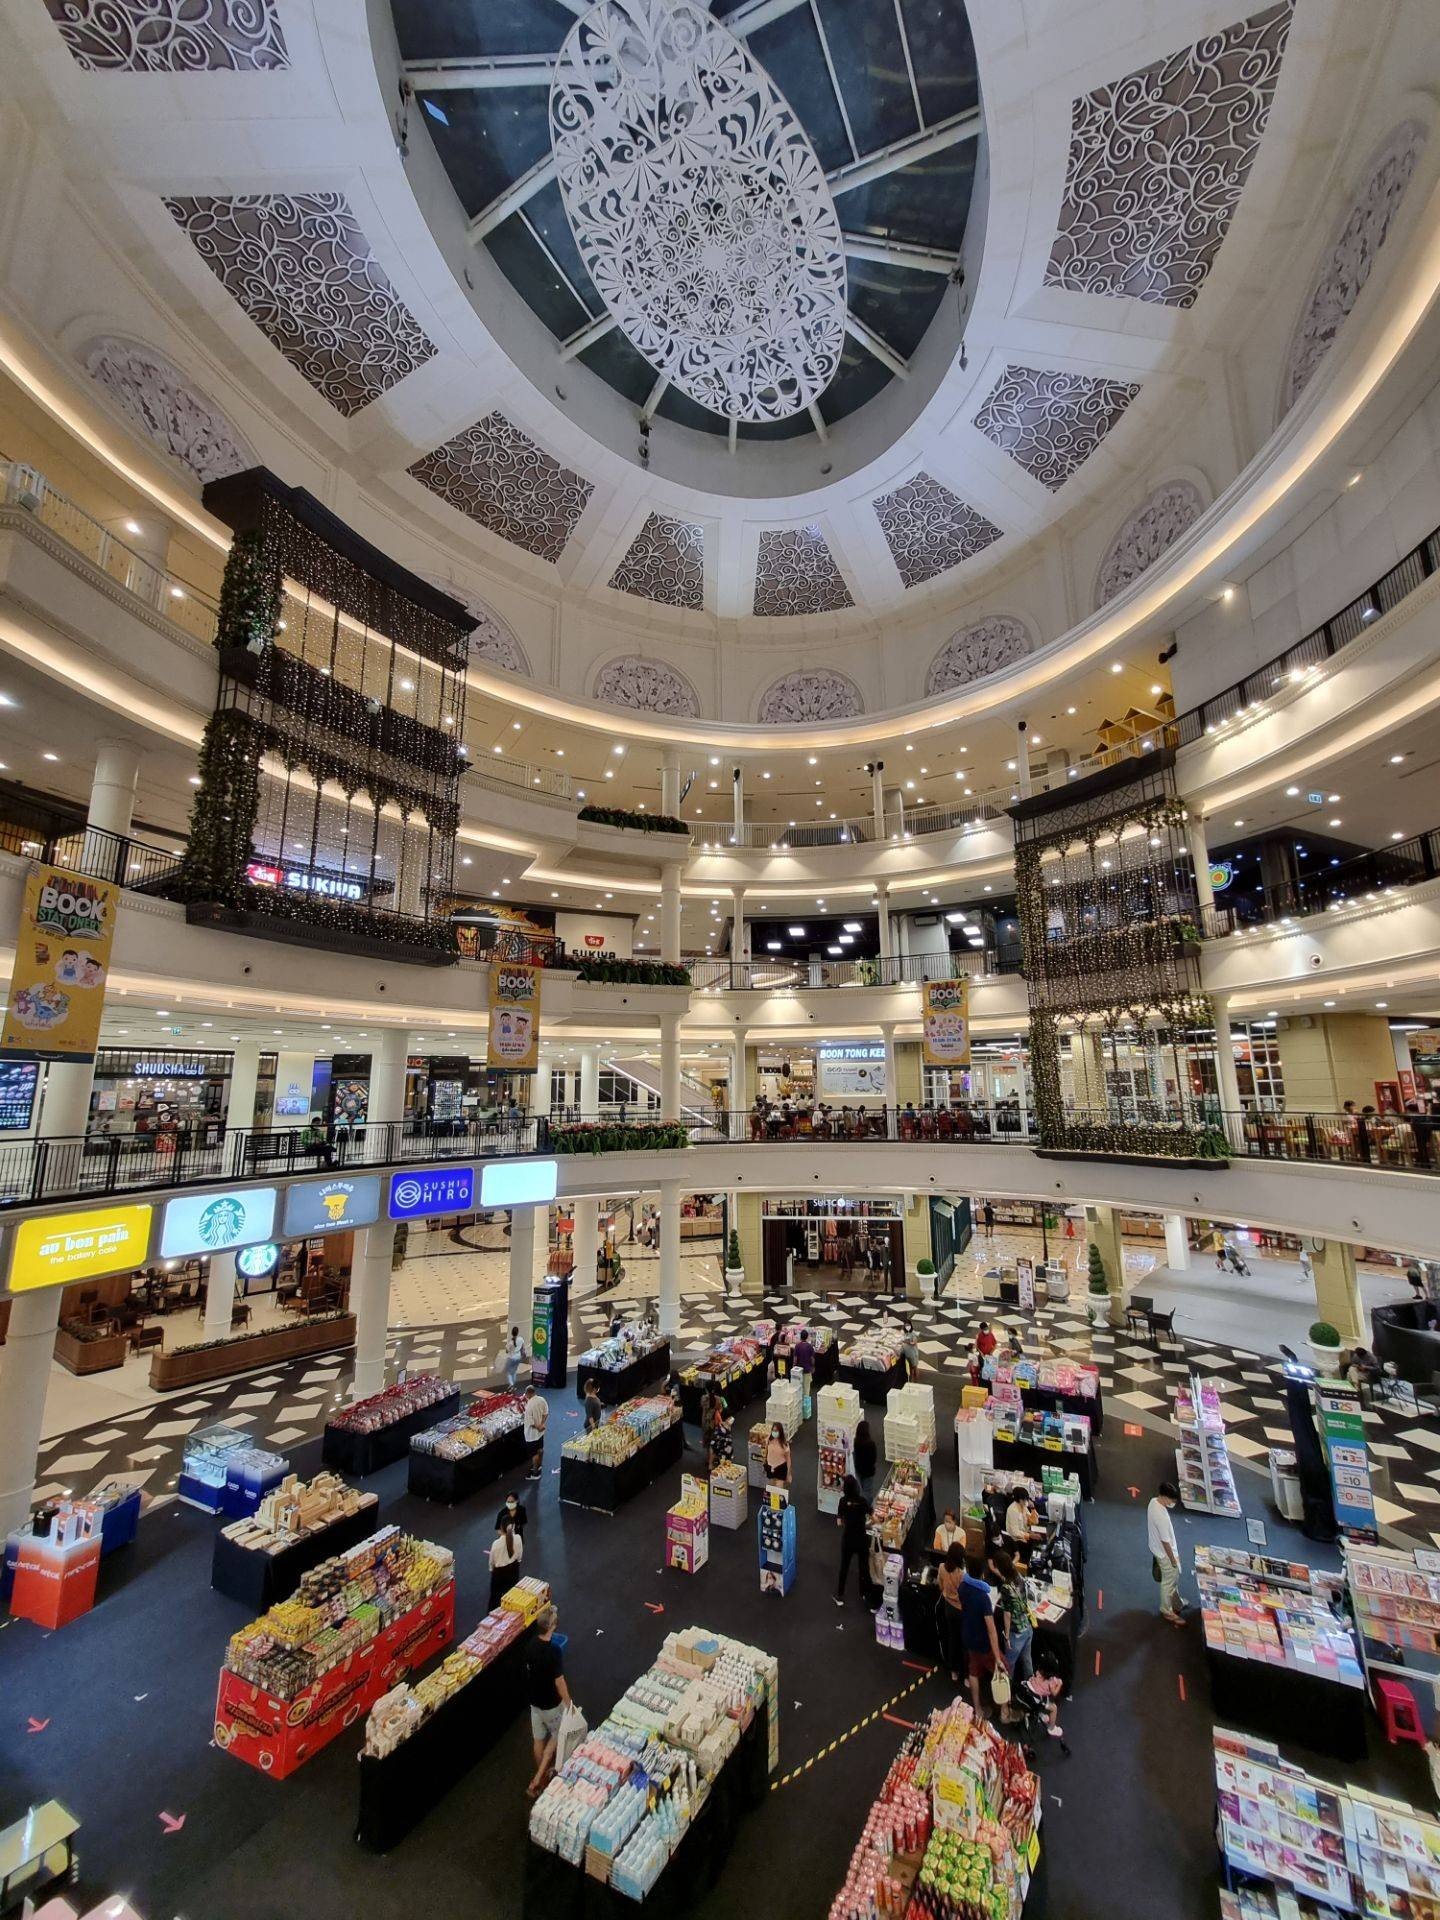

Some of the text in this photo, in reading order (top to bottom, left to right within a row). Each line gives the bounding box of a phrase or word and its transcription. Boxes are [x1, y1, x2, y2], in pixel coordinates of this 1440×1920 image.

[287, 872, 361, 900] SUKIYA
[40, 886, 105, 922] BOOK
[572, 949, 616, 959] SUKIYA
[498, 974, 534, 990] BOOK
[929, 988, 961, 999] BOOK
[820, 1048, 844, 1059] BOON
[845, 1048, 868, 1058] TONG
[423, 1180, 460, 1191] SUSHI
[423, 1187, 469, 1203] HIRO
[813, 1198, 856, 1208] SUITCBE
[39, 1226, 130, 1256] au bon pain
[50, 1255, 65, 1265] the
[1330, 1400, 1354, 1412] B2S
[713, 1486, 732, 1497] Scotch
